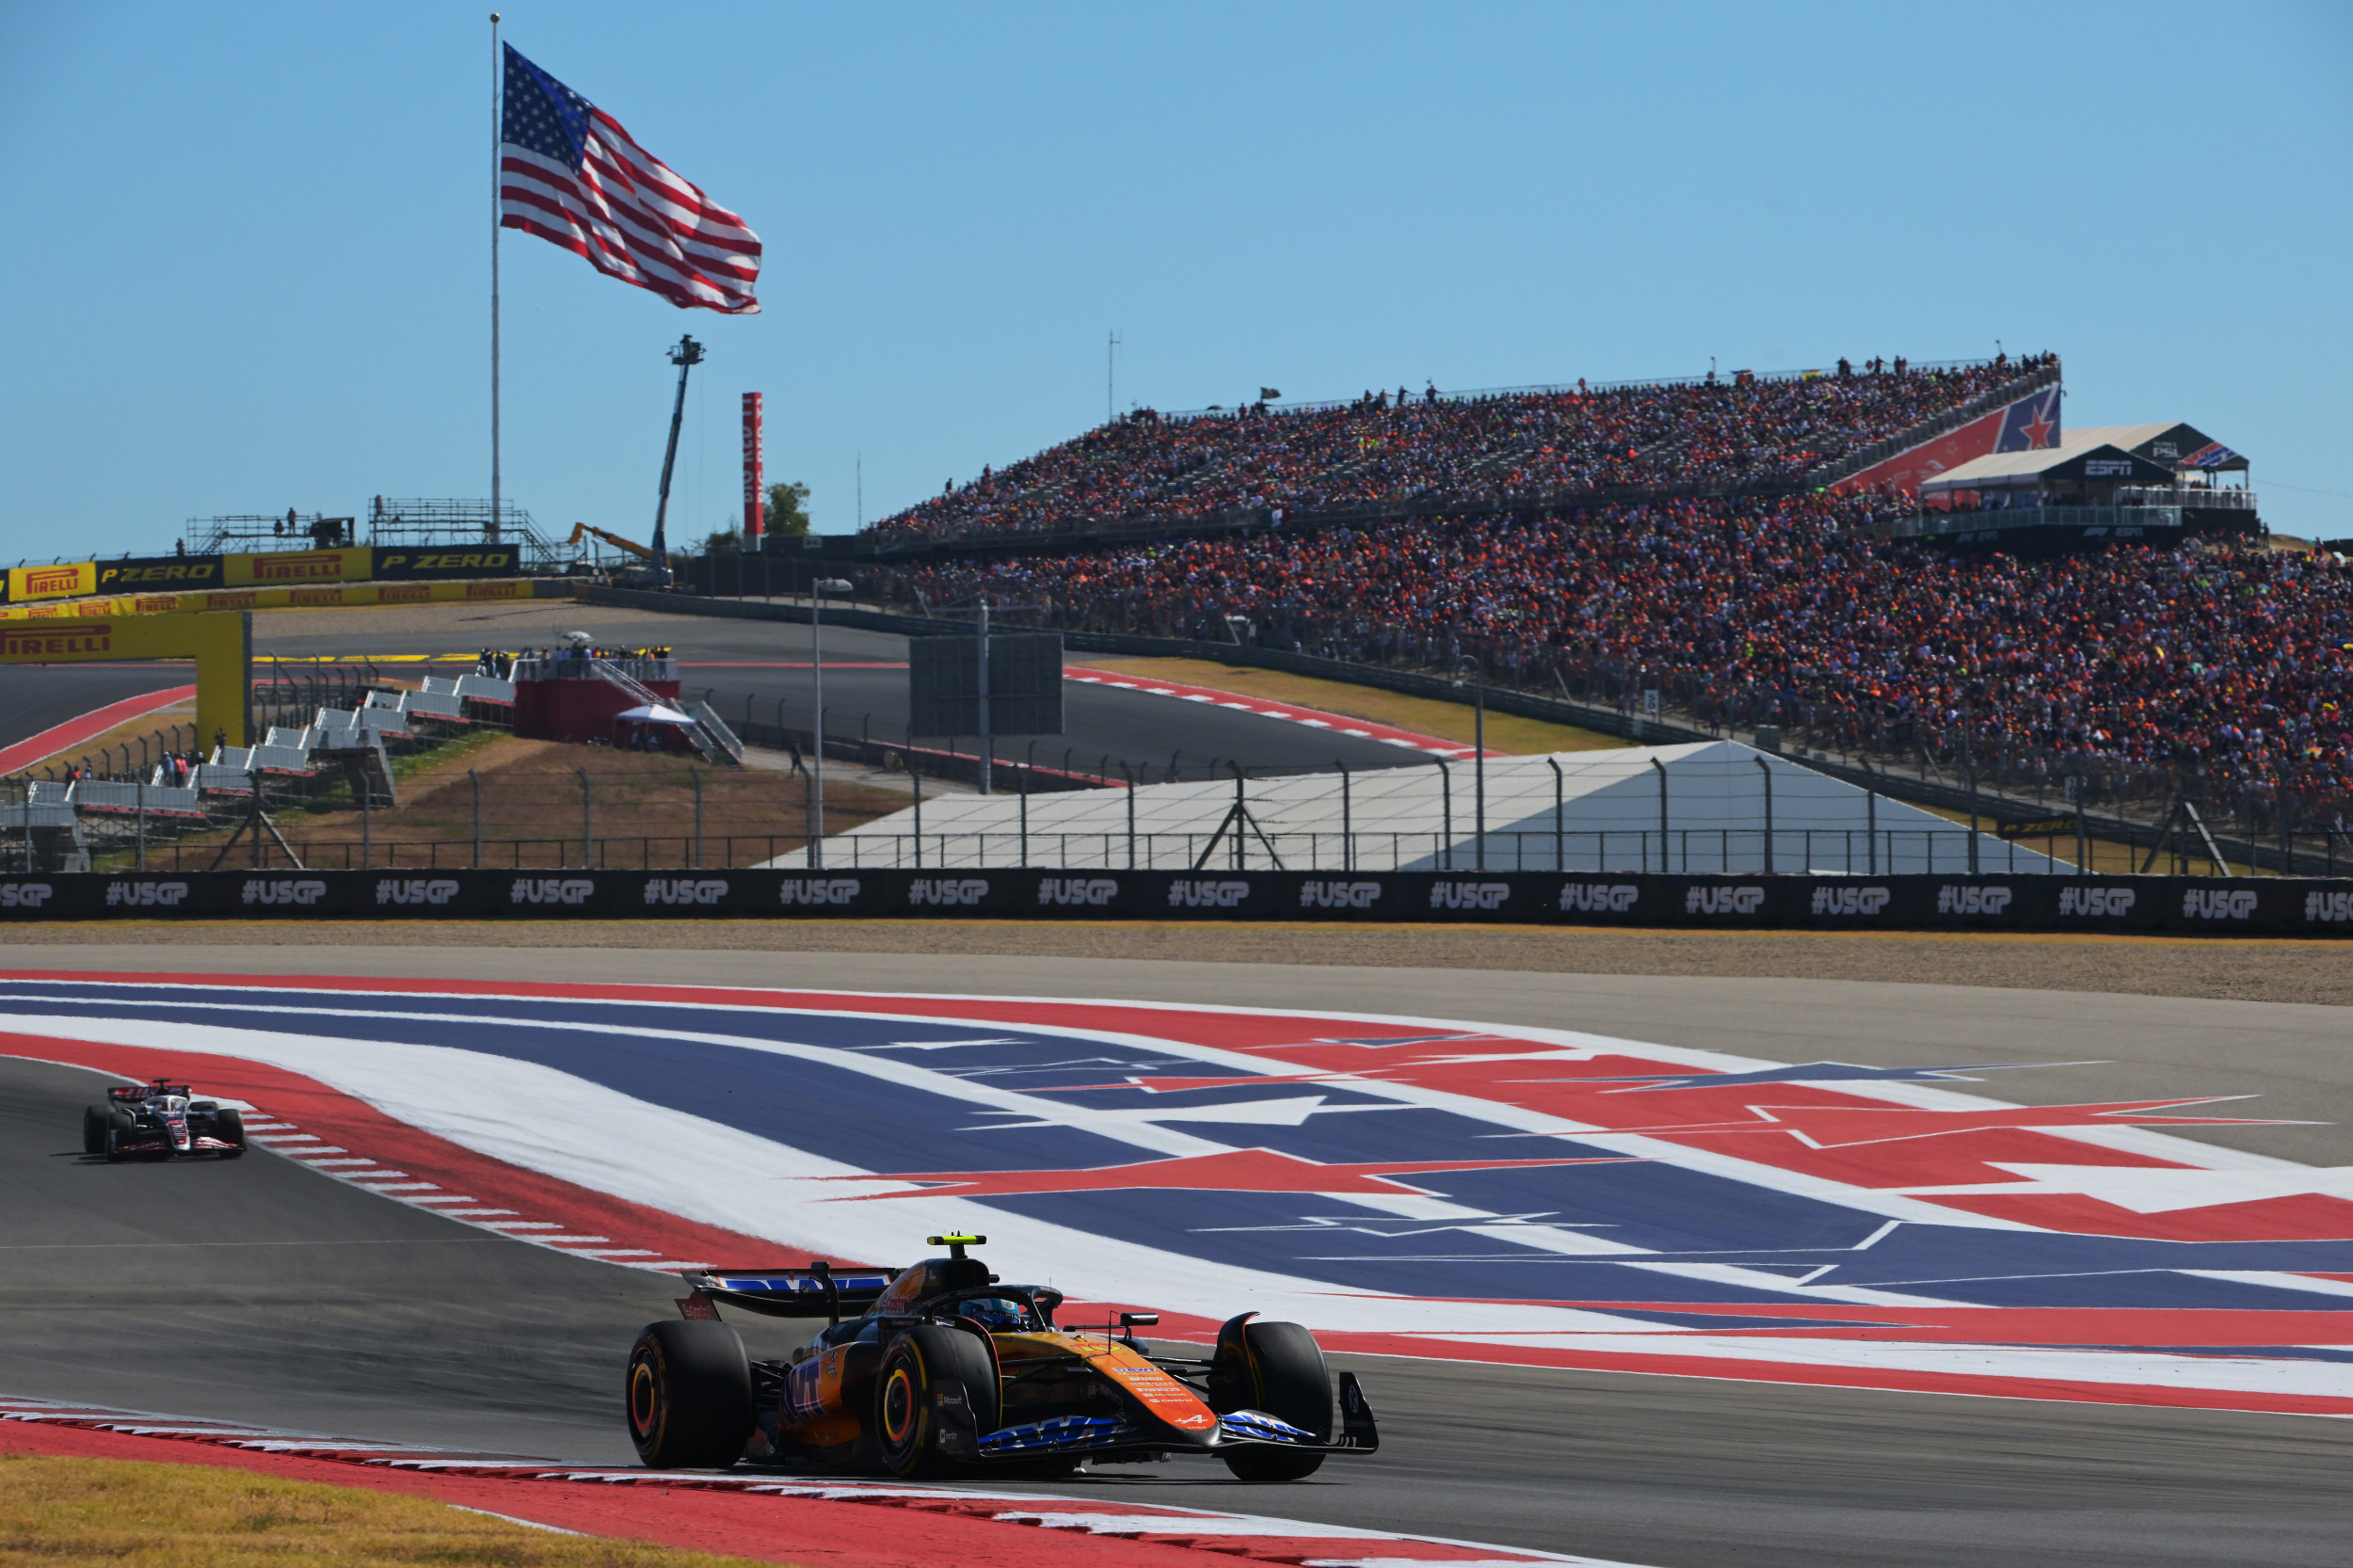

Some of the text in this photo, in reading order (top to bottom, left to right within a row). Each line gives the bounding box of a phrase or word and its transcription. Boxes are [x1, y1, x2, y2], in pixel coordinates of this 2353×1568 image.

[2085, 459, 2132, 475] ESPN
[253, 554, 343, 579] PIRELLI
[381, 553, 509, 569] P ZERO
[26, 568, 79, 594] PIRELLI
[101, 564, 216, 584] P ZERO
[136, 596, 178, 613] PIRELLI
[0, 624, 112, 655] PIRELLI
[2021, 820, 2078, 833] ZERO
[0, 884, 53, 907] SGP
[106, 882, 188, 906] #USGP
[242, 881, 327, 905] #USGP
[376, 880, 459, 905] #USGP
[511, 879, 595, 904] #USGP
[645, 880, 728, 904] #USGP
[780, 880, 860, 904] #USGP
[909, 880, 989, 905] #USGP
[1039, 879, 1118, 905] #USGP
[1169, 881, 1250, 907] #USGP
[1301, 881, 1382, 908] #USGP
[1431, 883, 1511, 909] #USGP
[1560, 884, 1639, 912] #USGP
[1687, 886, 1765, 915] #USGP
[1812, 887, 1891, 916] #USGP
[1938, 887, 2012, 916] #USGP
[2059, 888, 2136, 918] #USGP
[2184, 889, 2258, 920] #USGP
[943, 1395, 962, 1405] Microsoft
